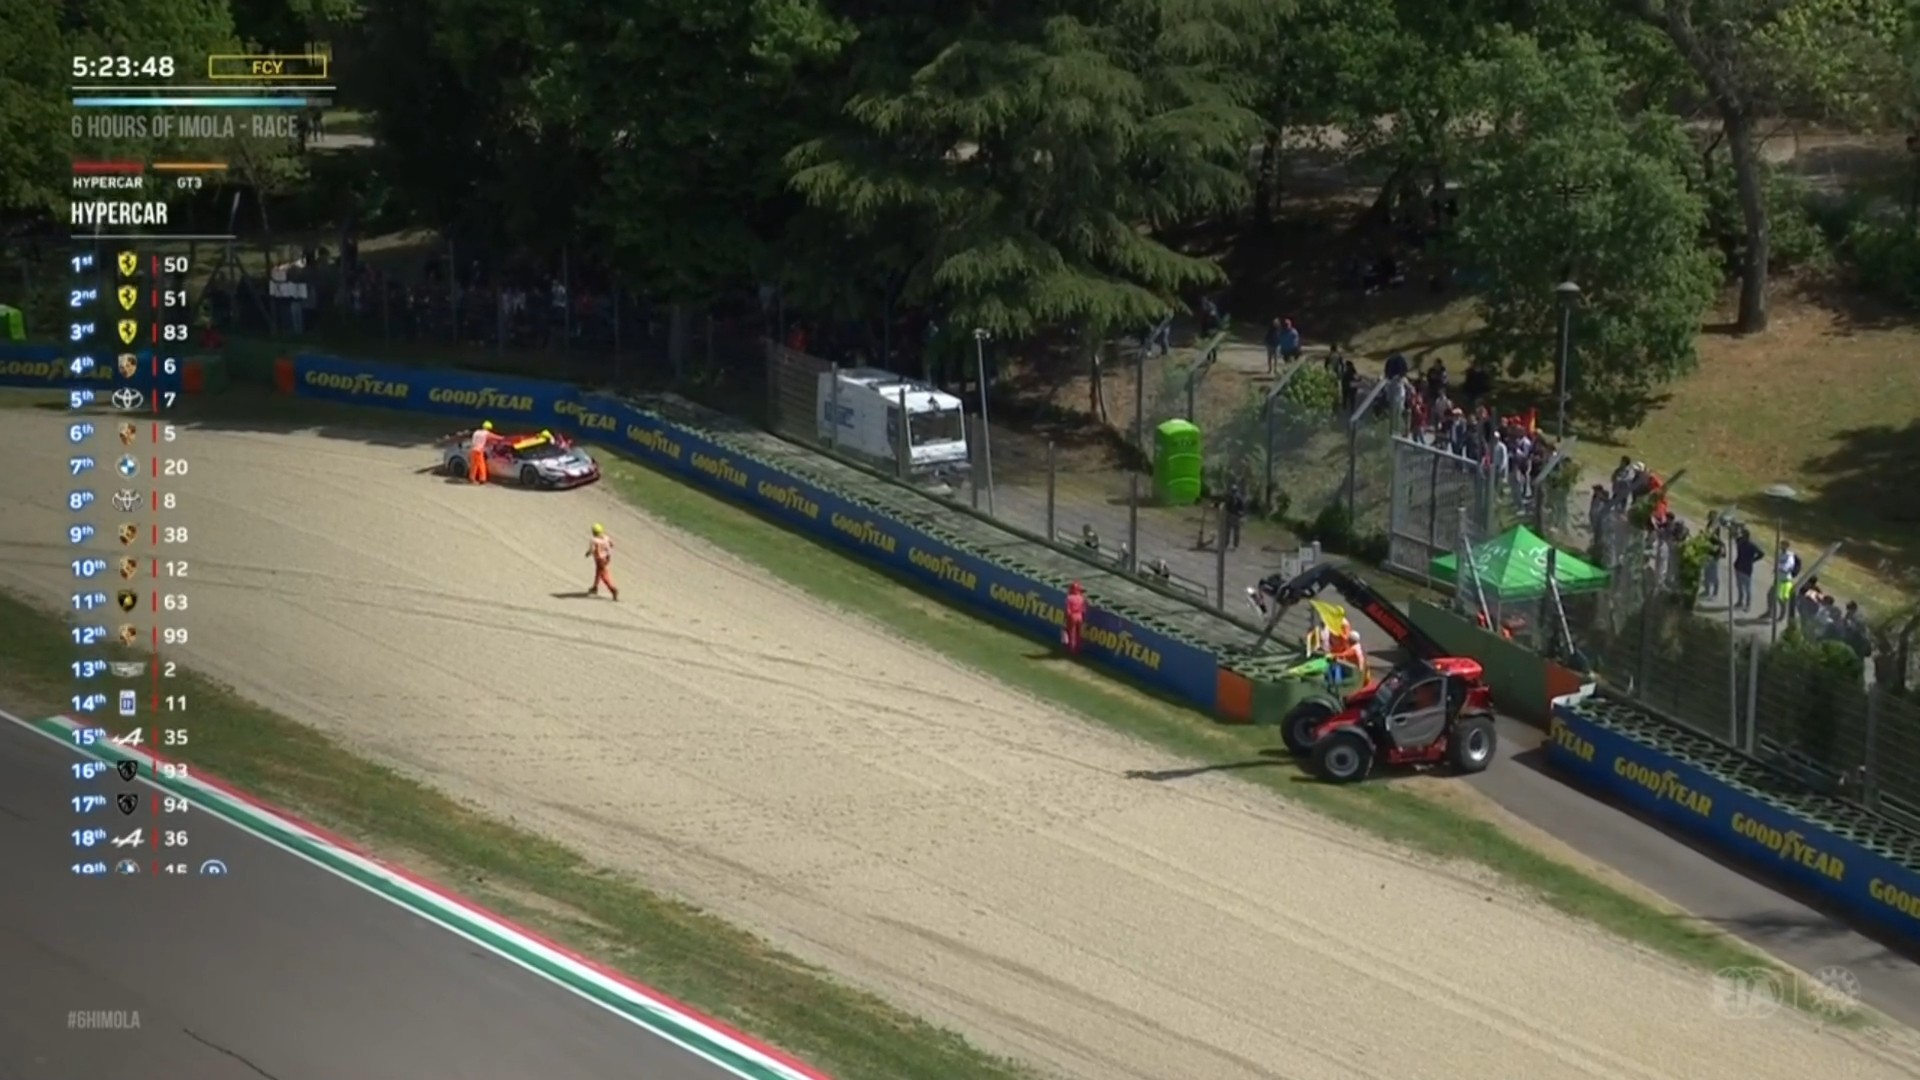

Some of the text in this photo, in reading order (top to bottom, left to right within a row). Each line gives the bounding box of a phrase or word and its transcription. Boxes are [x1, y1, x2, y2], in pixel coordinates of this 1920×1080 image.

[305, 369, 409, 398] GOODYEAR
[429, 386, 533, 412] GOODYEAR
[626, 424, 682, 460] GOODYEAR
[691, 450, 748, 489] GOODYEAR
[758, 479, 820, 520] GOODYEAR
[831, 511, 897, 554] GOODYEAR
[908, 546, 977, 591] GOODYEAR
[989, 582, 1065, 627] GOODYEAR
[1614, 756, 1713, 818] GOODYEAR
[1731, 811, 1846, 881] GOODYEAR
